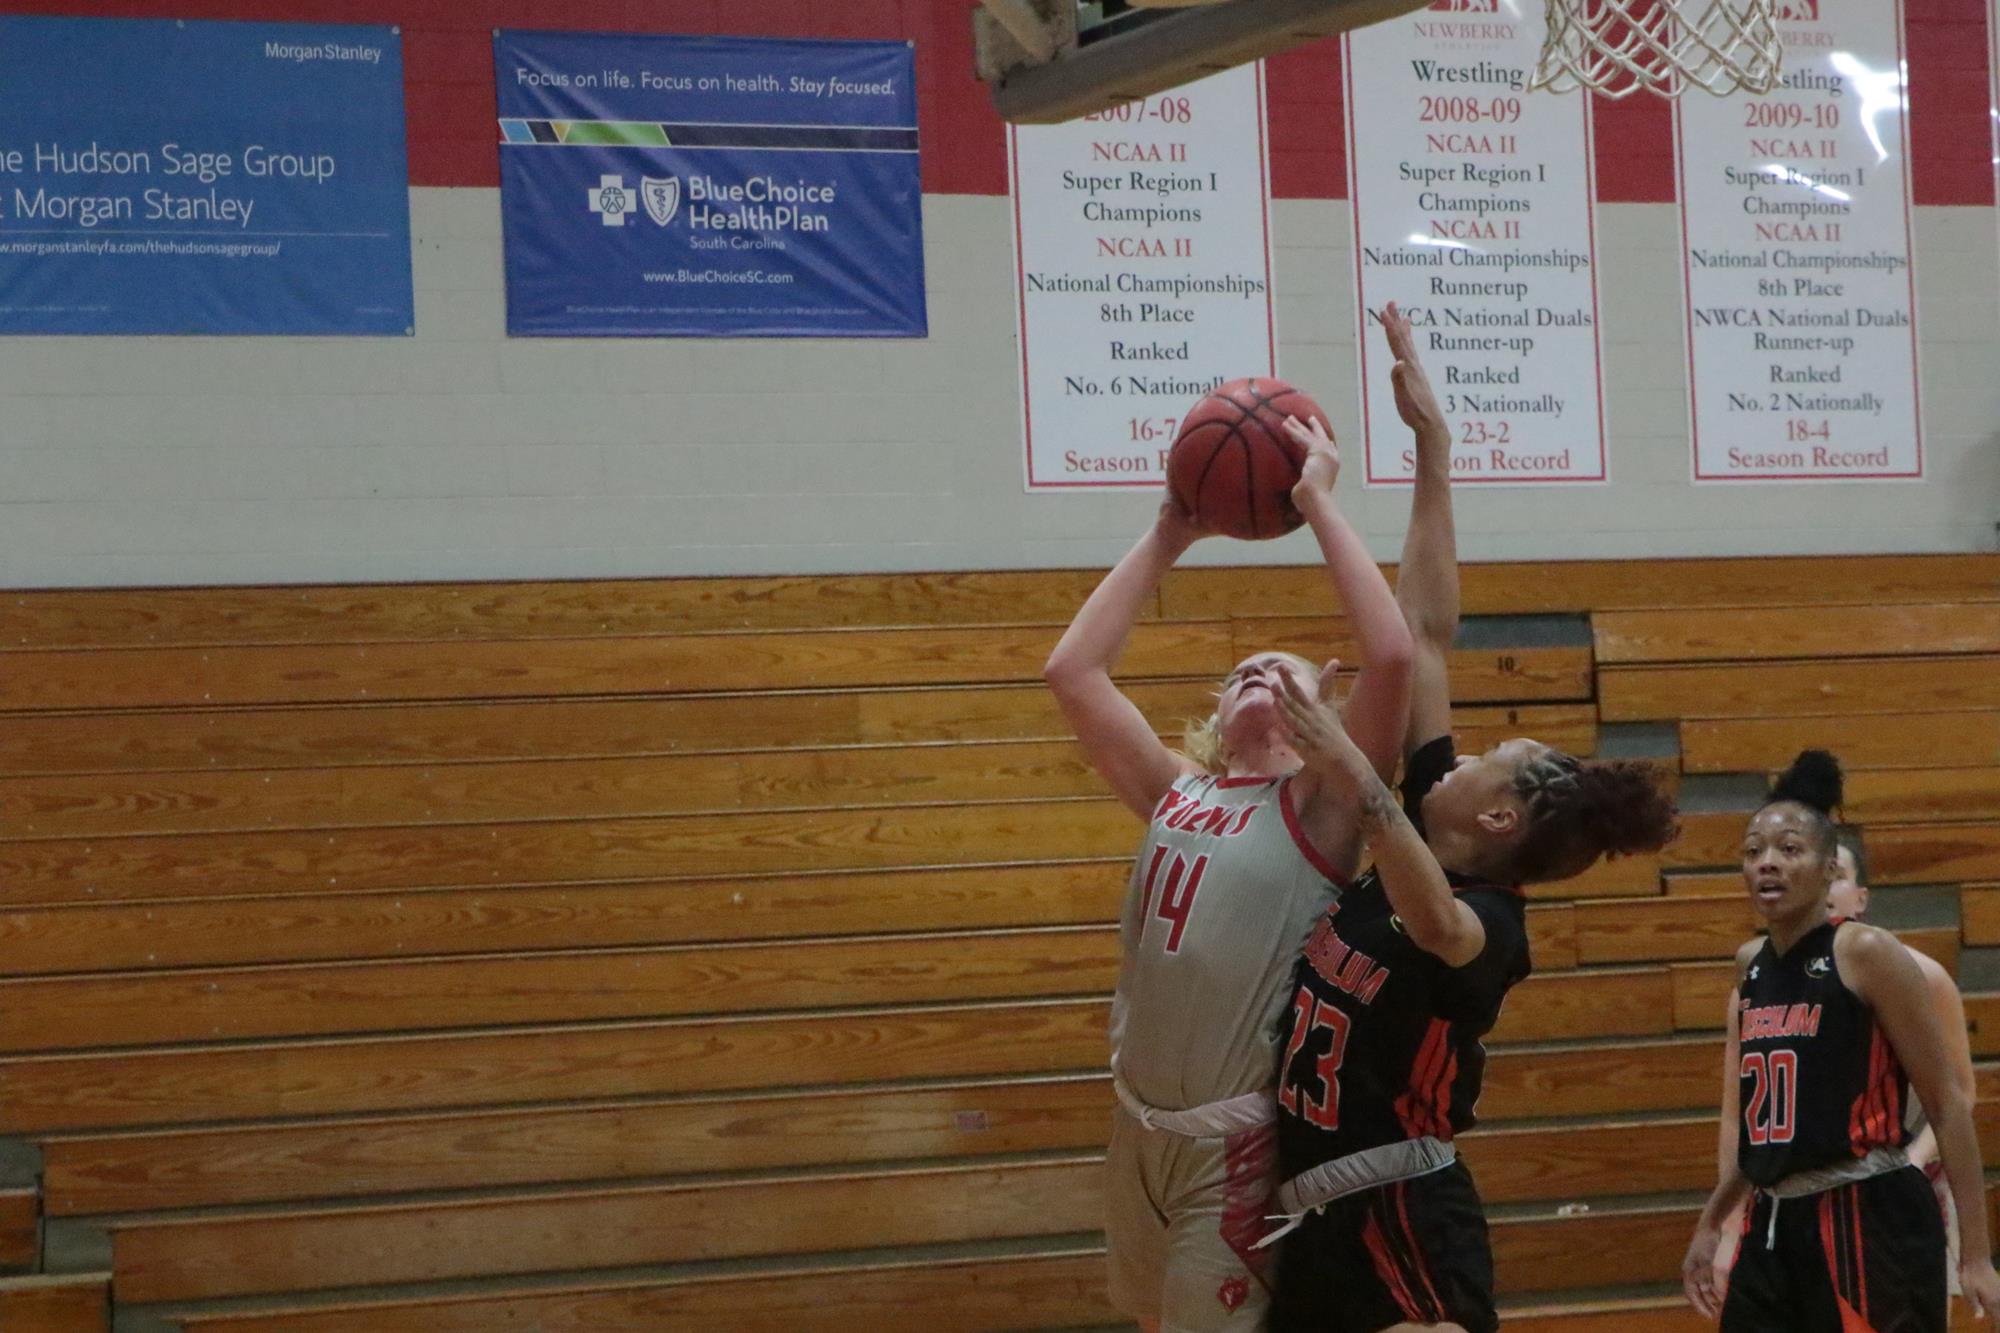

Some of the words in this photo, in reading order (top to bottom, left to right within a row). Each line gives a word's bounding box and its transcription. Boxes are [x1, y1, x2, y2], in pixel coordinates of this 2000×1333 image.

[1413, 22, 1518, 40] NEWBERRY
[517, 68, 569, 87] Focus
[575, 75, 598, 88] on
[604, 70, 635, 89] life.
[642, 72, 692, 91] Focus
[698, 77, 720, 91] on
[726, 73, 785, 92] health.
[789, 76, 825, 97] Stay
[828, 76, 896, 98] focused.
[1411, 60, 1525, 92] Wrestling
[1418, 95, 1521, 124] 2008-09
[1744, 103, 1839, 130] 2009-10
[1092, 141, 1163, 163] NCAA
[1170, 142, 1187, 163] II
[1427, 135, 1494, 155] NCAA
[1500, 136, 1517, 155] II
[1751, 139, 1814, 159] NCAA
[1821, 140, 1838, 159] II
[35, 141, 151, 174] Hudson
[162, 143, 232, 183] Sage
[244, 145, 335, 185] Group
[1063, 172, 1122, 196] Super
[1130, 173, 1202, 196] Region
[1399, 162, 1456, 186] Super
[1462, 164, 1533, 188] Region
[1725, 166, 1779, 191] Super
[689, 175, 835, 203] BlueChoice
[15, 187, 132, 228] Morgan
[143, 187, 254, 229] Stanley
[1083, 201, 1202, 228] Champions
[1419, 192, 1531, 217] Champions
[1743, 196, 1851, 221] Champions
[690, 205, 829, 231] HealthPlan
[1431, 221, 1498, 240] NCAA
[1504, 221, 1521, 240] II
[1756, 224, 1820, 242] NCAA
[1825, 225, 1841, 242] II
[690, 236, 728, 250] South
[730, 236, 786, 250] Carolina
[1097, 239, 1168, 258] NCAA
[1175, 239, 1193, 258] II
[1364, 247, 1444, 268] National
[1449, 248, 1589, 273] Championships
[1691, 249, 1767, 270] National
[1772, 250, 1907, 274] Championships
[643, 269, 794, 285] www.BlueChoiceSC.com
[1026, 273, 1111, 293] National
[1116, 273, 1266, 299] Championships
[1758, 279, 1787, 298] 8th
[1793, 280, 1844, 298] Place
[1430, 277, 1528, 302] Runnerup
[1100, 304, 1134, 323] 8th
[1141, 304, 1195, 323] Place
[1445, 307, 1530, 328] National
[1537, 308, 1592, 329] Duals
[1695, 309, 1761, 328] NWCA
[1768, 309, 1850, 328] National
[1857, 310, 1909, 328] Duals
[1110, 342, 1189, 361] Ranked
[1430, 332, 1534, 357] Runner-up
[1754, 332, 1854, 357] Runner-up
[1446, 366, 1520, 385] Ranked
[1770, 365, 1841, 384] Ranked
[1065, 377, 1104, 396] No.
[1111, 377, 1122, 395] 6
[1445, 395, 1457, 414] 3
[1463, 395, 1565, 418] Nationally
[1728, 394, 1764, 413] No.
[1770, 394, 1782, 413] 2
[1786, 394, 1884, 417] Nationally
[1462, 422, 1511, 444] 23-2
[1786, 420, 1831, 442] 18-4
[1064, 450, 1149, 473] Season
[1491, 449, 1570, 471] Record
[1728, 447, 1806, 469] Season
[1812, 446, 1890, 468] Record
[1139, 842, 1211, 956] 14
[1278, 983, 1351, 1132] 23
[1740, 1049, 1798, 1145] 20
